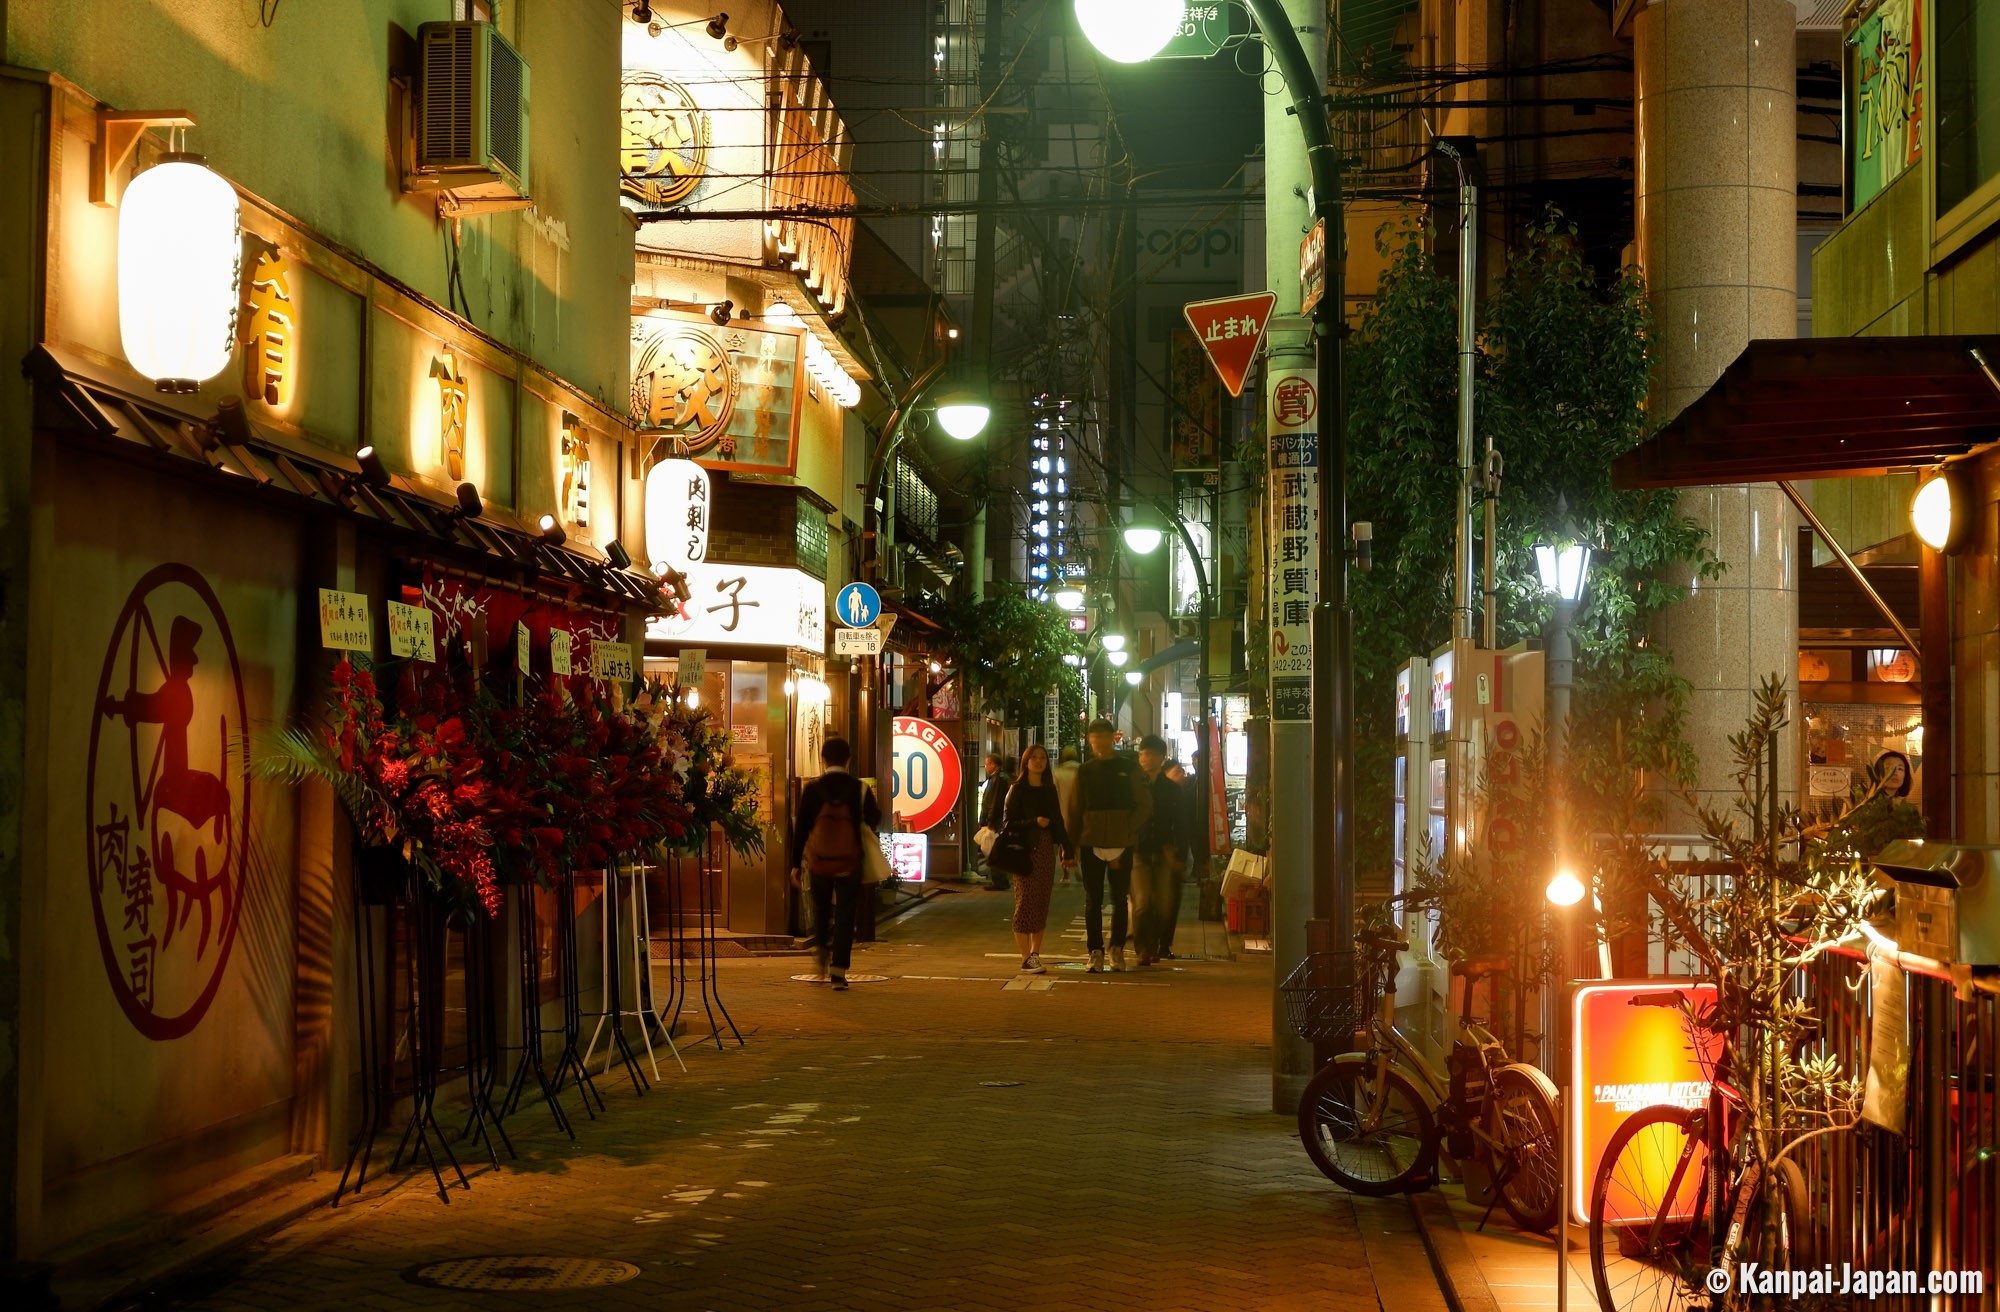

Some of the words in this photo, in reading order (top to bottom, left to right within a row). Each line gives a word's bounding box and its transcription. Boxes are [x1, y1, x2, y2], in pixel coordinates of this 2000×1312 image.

[1204, 315, 1260, 342] 止まれ
[637, 340, 723, 432] 餃
[1276, 383, 1311, 425] 質
[1278, 451, 1313, 466] 横通り
[686, 474, 707, 561] 肉刺し
[1282, 473, 1310, 627] 武蔵野質庫
[706, 577, 760, 632] 子
[838, 631, 879, 641] 自転車を除く
[841, 642, 847, 651] 9
[867, 642, 876, 651] 18
[601, 658, 631, 680] 山田文彦
[1276, 687, 1312, 700] 吉祥寺本
[94, 801, 158, 1016] 肉寿司
